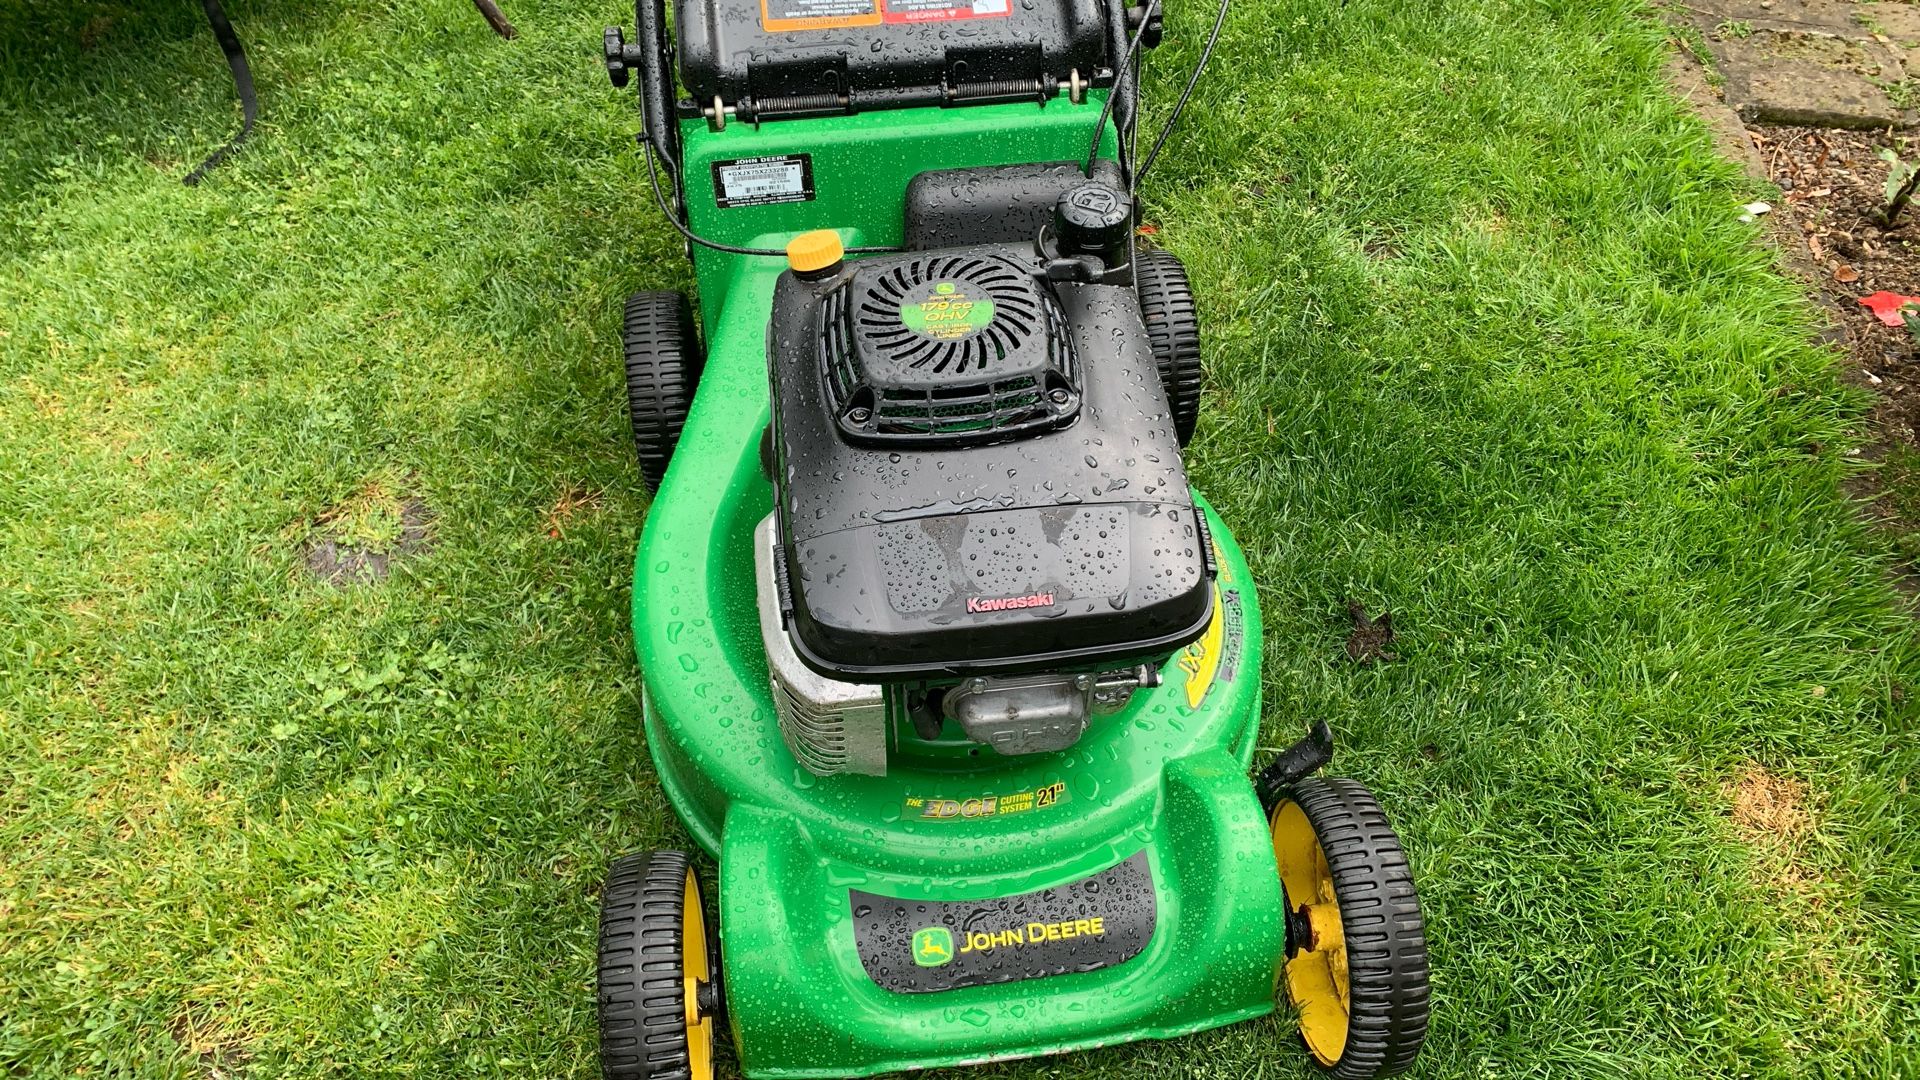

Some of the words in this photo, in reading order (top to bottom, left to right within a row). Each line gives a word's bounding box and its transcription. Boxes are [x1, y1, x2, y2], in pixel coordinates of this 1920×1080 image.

[906, 10, 945, 20] DANGER
[921, 301, 950, 311] 179
[951, 302, 973, 310] cc
[925, 310, 970, 321] OHV
[967, 591, 1054, 613] Kawasaki
[991, 723, 1075, 743] OHV
[1000, 792, 1034, 805] CUTTING
[1036, 782, 1065, 808] 21"
[906, 798, 923, 807] THE
[921, 797, 997, 817] EDGE
[999, 801, 1033, 815] SYSTEM
[960, 928, 1024, 953] JOHN
[1026, 917, 1106, 943] DEERE
